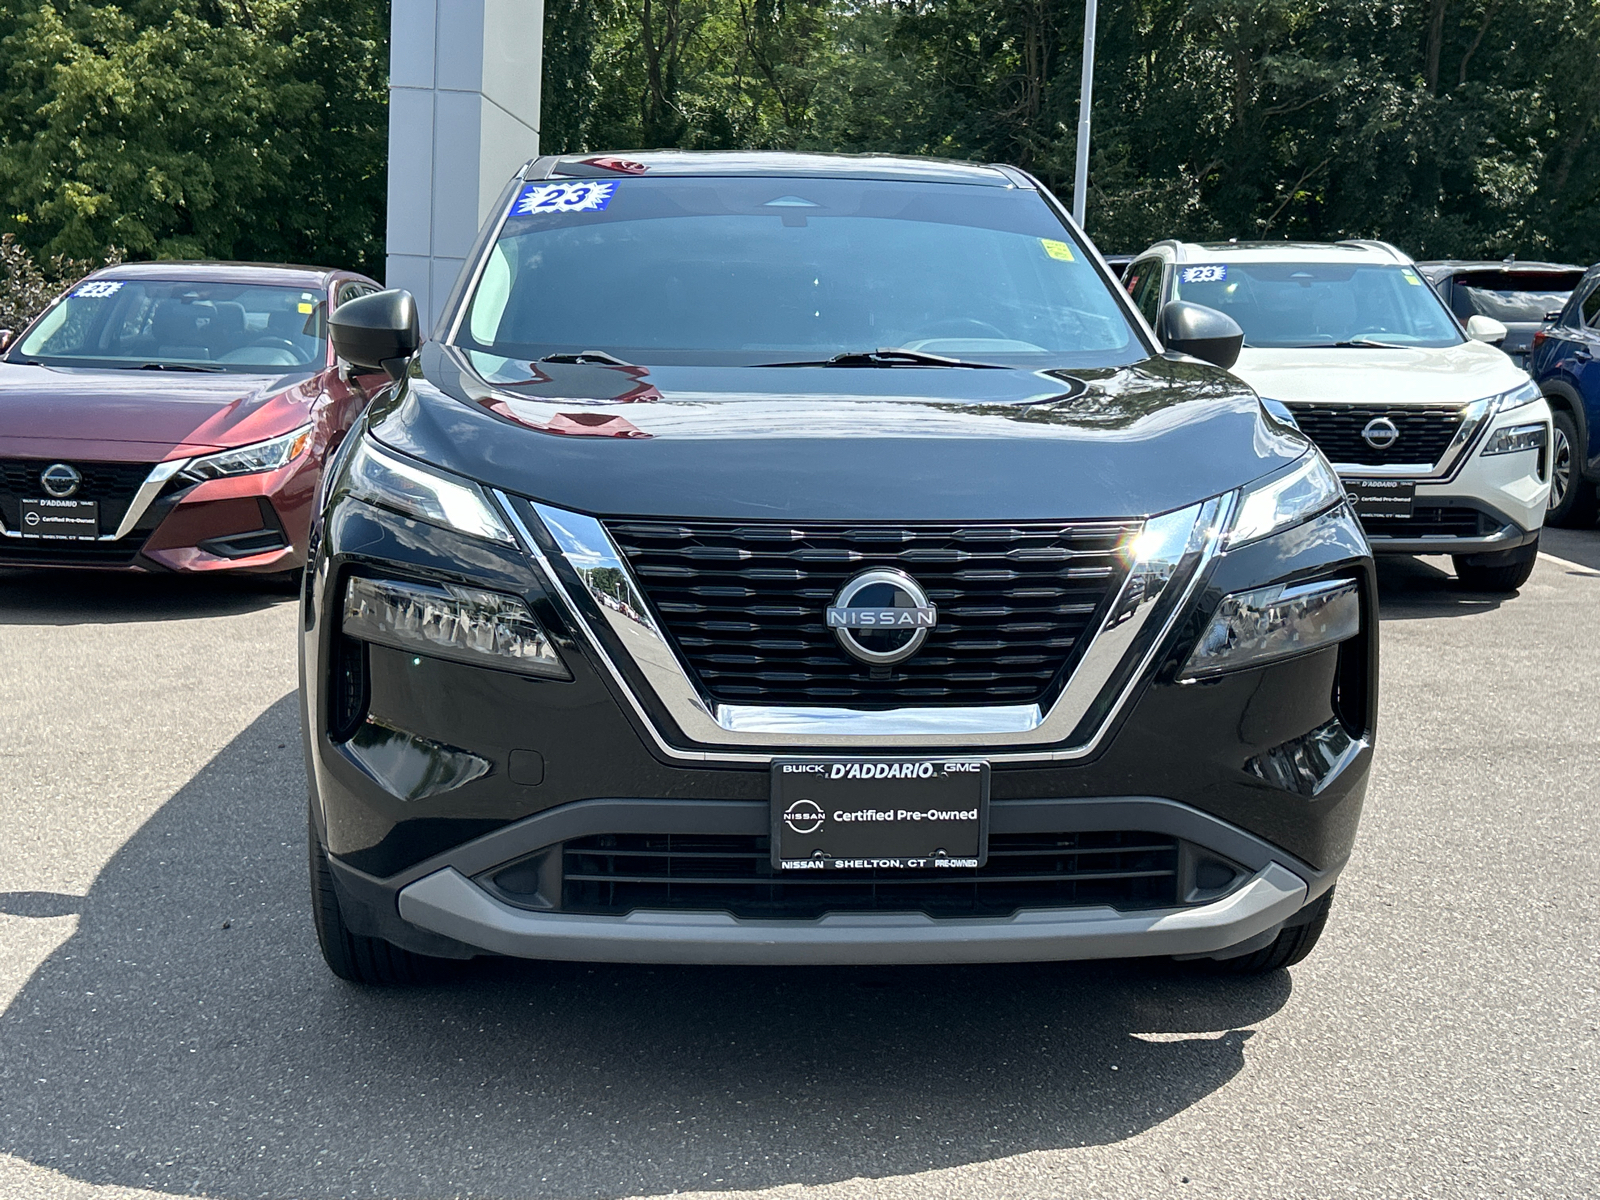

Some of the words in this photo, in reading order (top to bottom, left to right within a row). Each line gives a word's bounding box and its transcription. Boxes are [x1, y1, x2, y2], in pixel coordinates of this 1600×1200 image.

[535, 187, 591, 208] 23
[1192, 269, 1216, 279] 23
[40, 500, 77, 508] D'ADDARIO
[830, 611, 933, 625] NISSAN
[782, 764, 825, 773] BUICK
[830, 763, 933, 779] D'ADDARIO
[943, 763, 980, 772] GMC
[833, 809, 894, 822] Certified
[897, 808, 978, 821] Pre-Owned
[781, 861, 824, 869] NISSAN
[834, 859, 904, 869] SHELTON,
[907, 859, 927, 868] CT
[934, 859, 978, 868] PRE-OWNED
